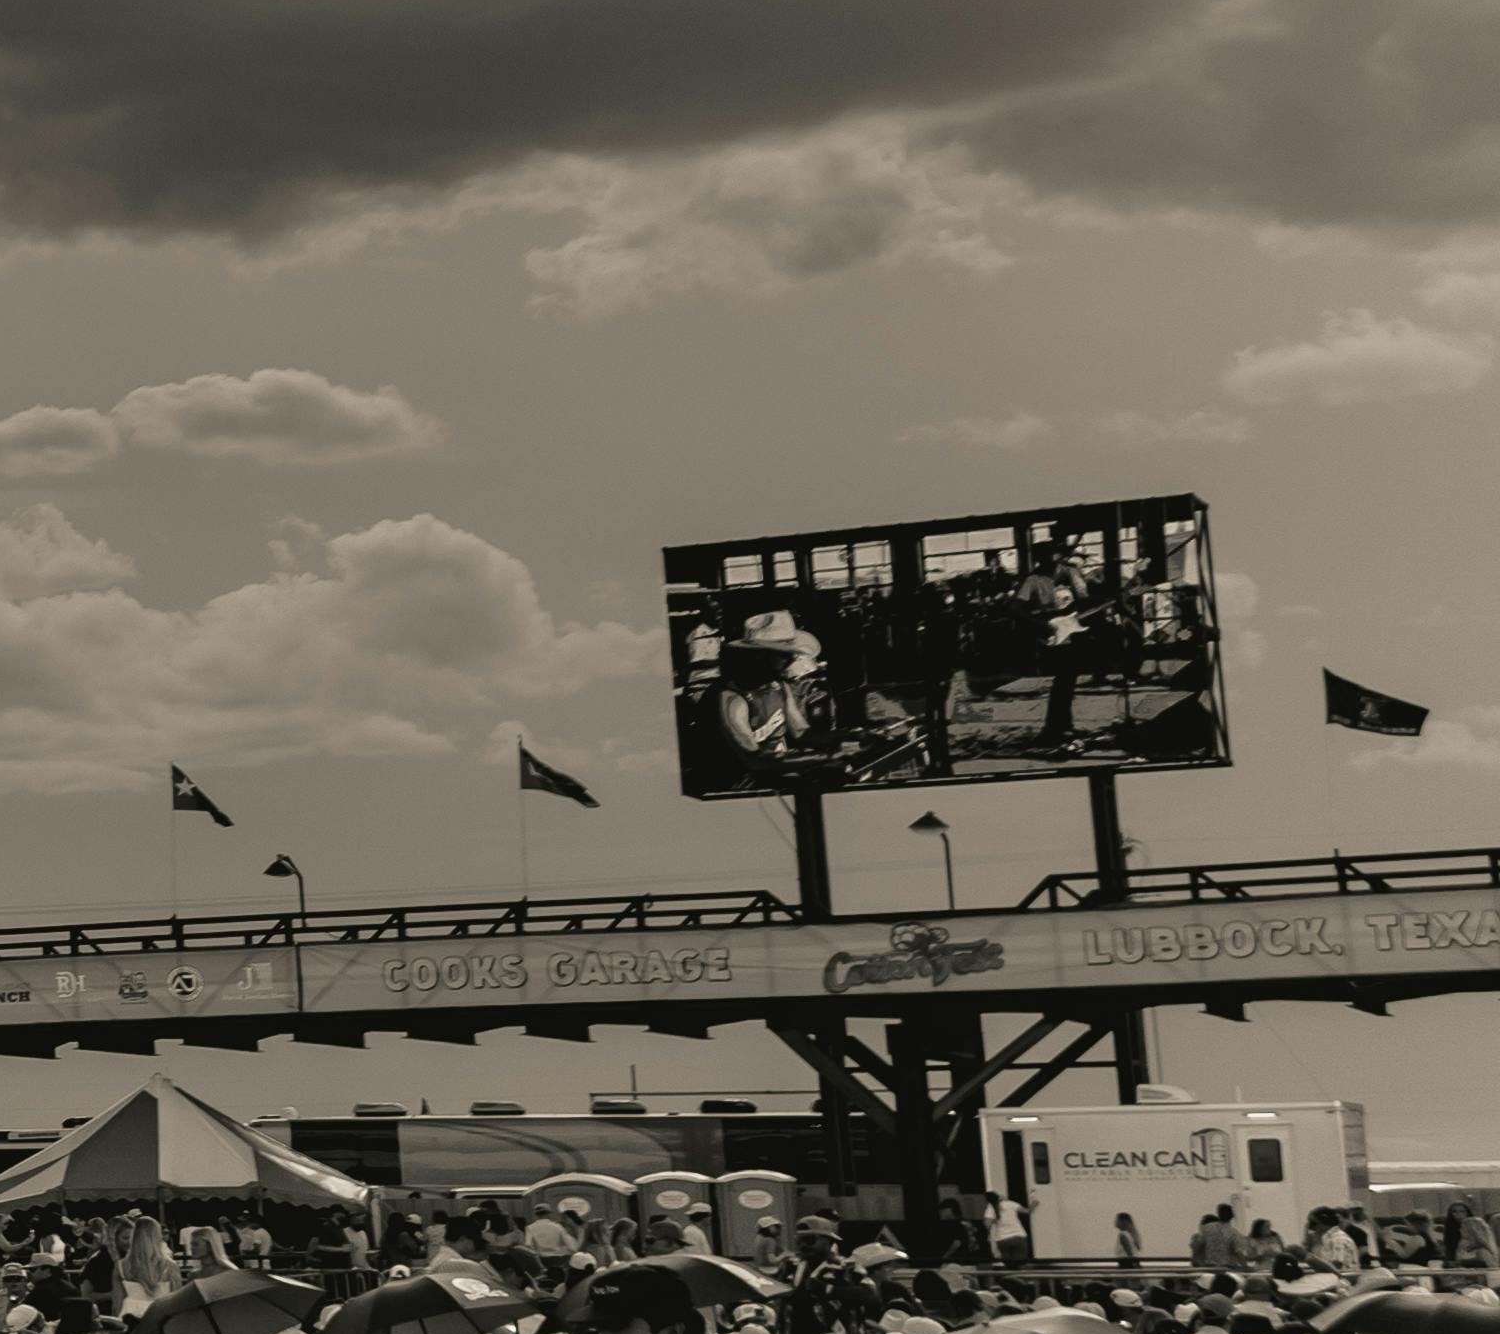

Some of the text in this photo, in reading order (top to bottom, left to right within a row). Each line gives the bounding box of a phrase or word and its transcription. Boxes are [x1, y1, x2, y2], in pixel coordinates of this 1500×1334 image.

[1082, 909, 1500, 966] LUBBOCK, TEXA
[382, 947, 732, 993] COOKS GARAGE
[1063, 1150, 1209, 1168] CLEAN CAN
